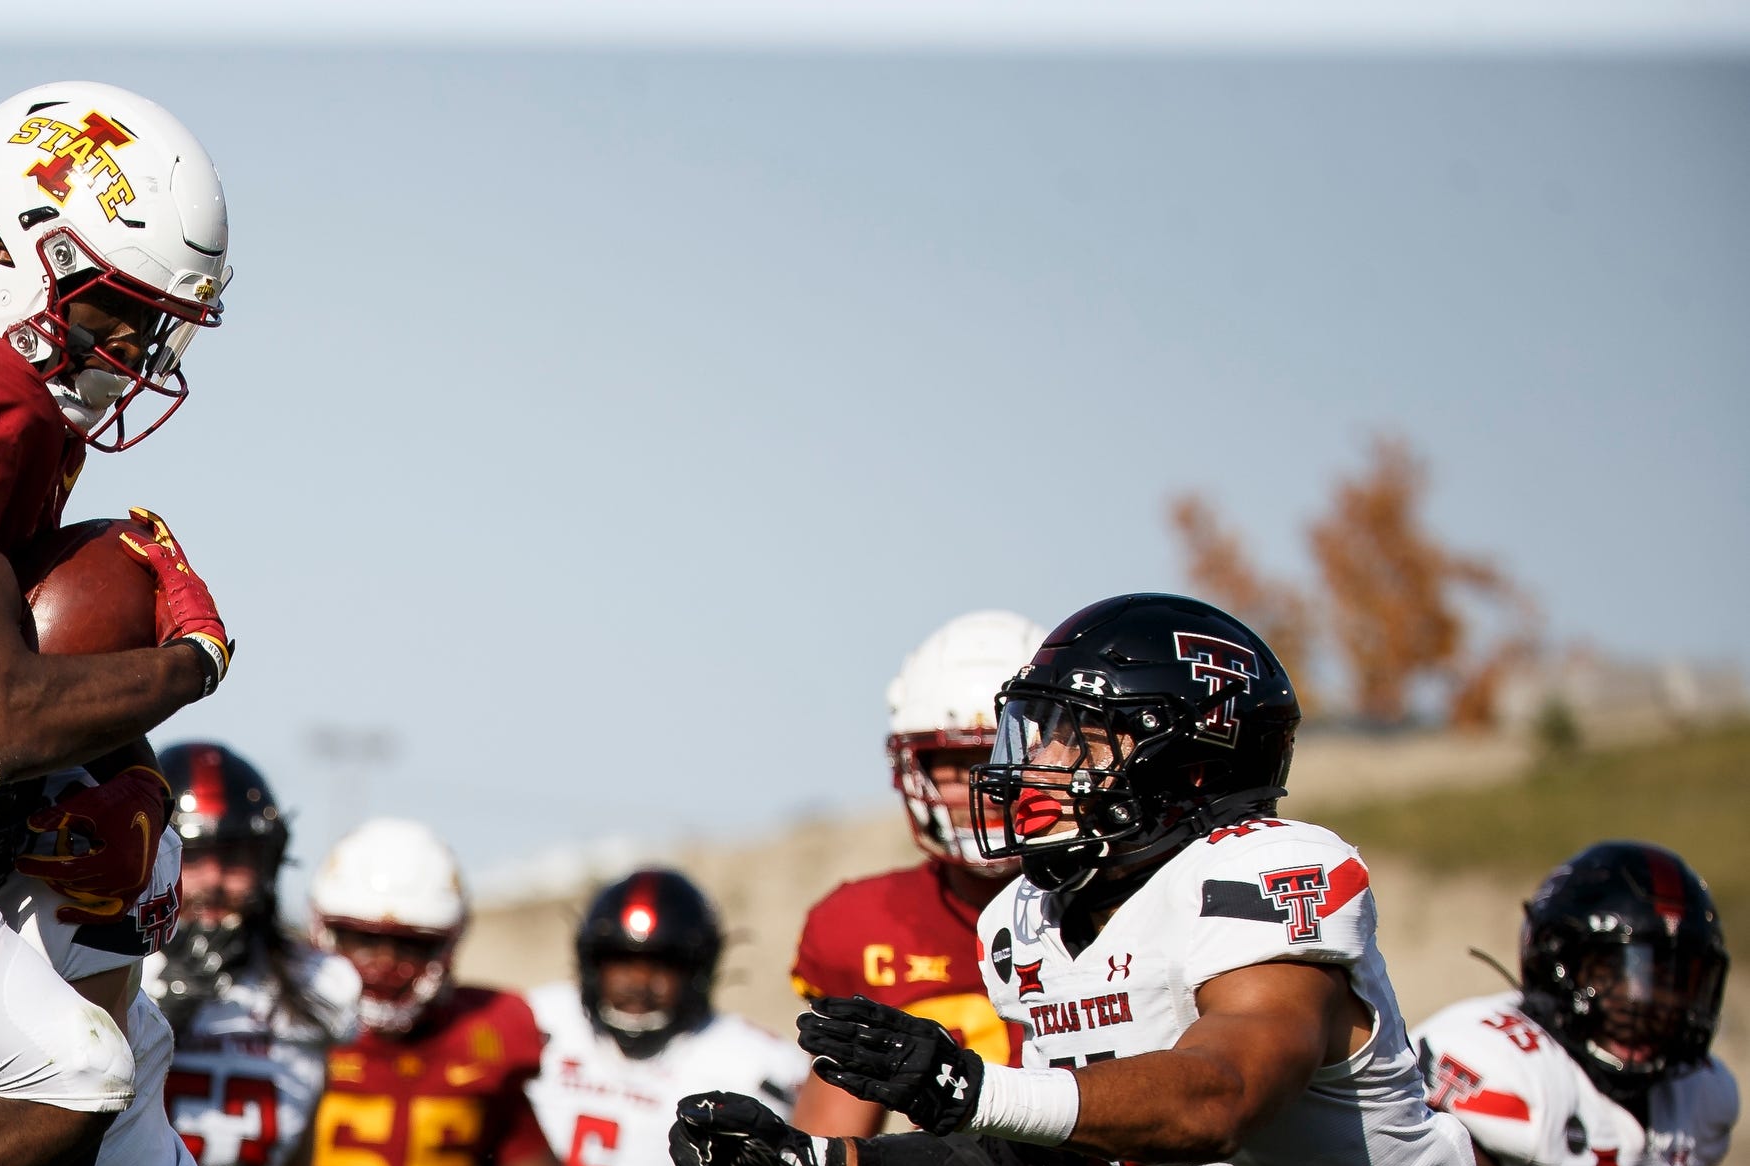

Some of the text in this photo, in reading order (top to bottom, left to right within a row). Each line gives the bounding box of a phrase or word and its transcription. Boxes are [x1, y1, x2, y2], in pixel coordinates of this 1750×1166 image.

[7, 115, 136, 223] STATE
[863, 944, 896, 986] C
[1030, 1002, 1081, 1037] TEXAS
[1080, 992, 1133, 1029] TECH
